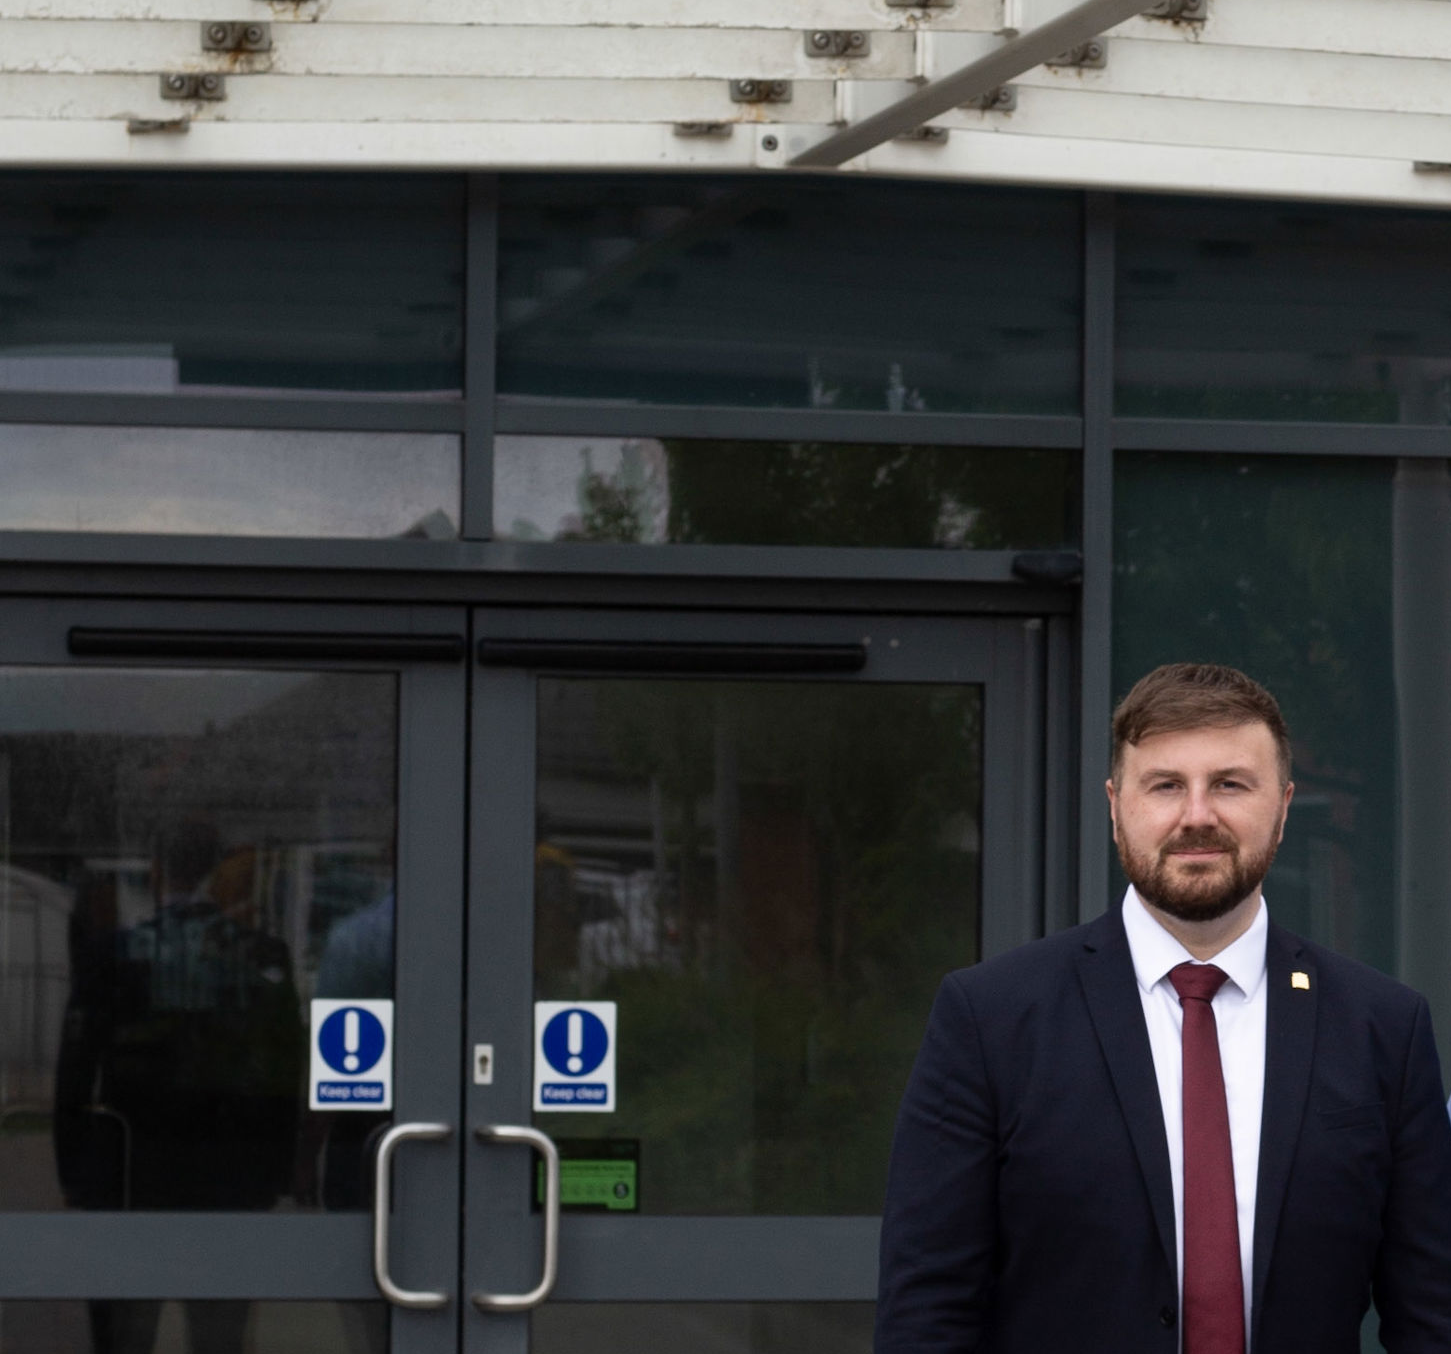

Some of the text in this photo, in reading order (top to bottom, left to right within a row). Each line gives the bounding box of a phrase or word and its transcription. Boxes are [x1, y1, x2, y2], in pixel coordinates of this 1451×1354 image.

[320, 1084, 382, 1101] Keep clear
[543, 1086, 605, 1102] Keep clear
